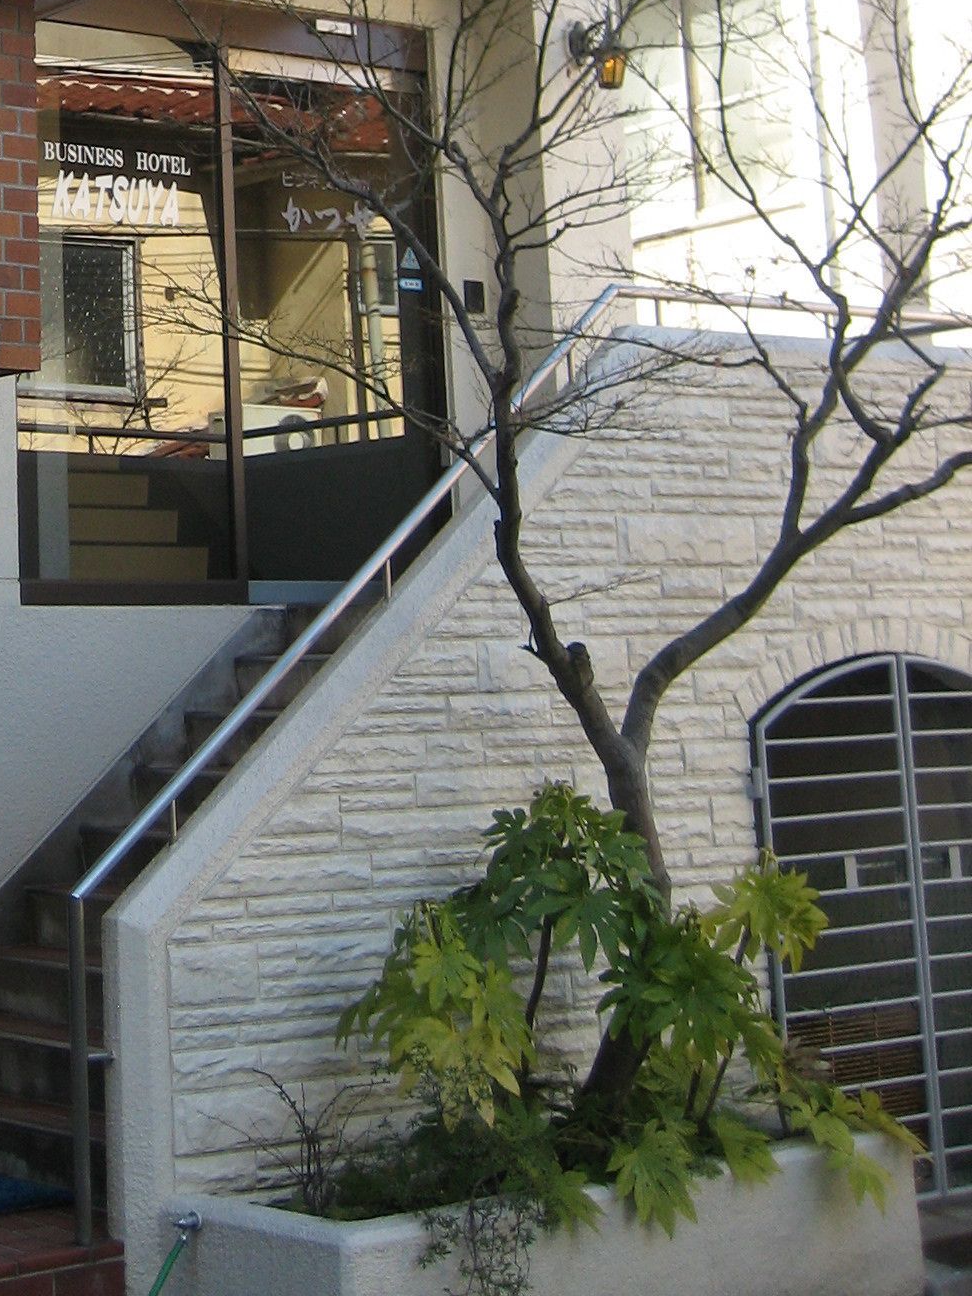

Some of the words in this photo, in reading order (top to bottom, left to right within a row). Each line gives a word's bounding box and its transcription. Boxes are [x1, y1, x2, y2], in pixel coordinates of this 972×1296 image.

[43, 140, 125, 169] BUSINESS
[135, 150, 192, 177] HOTEL
[51, 168, 180, 228] KATSUYA
